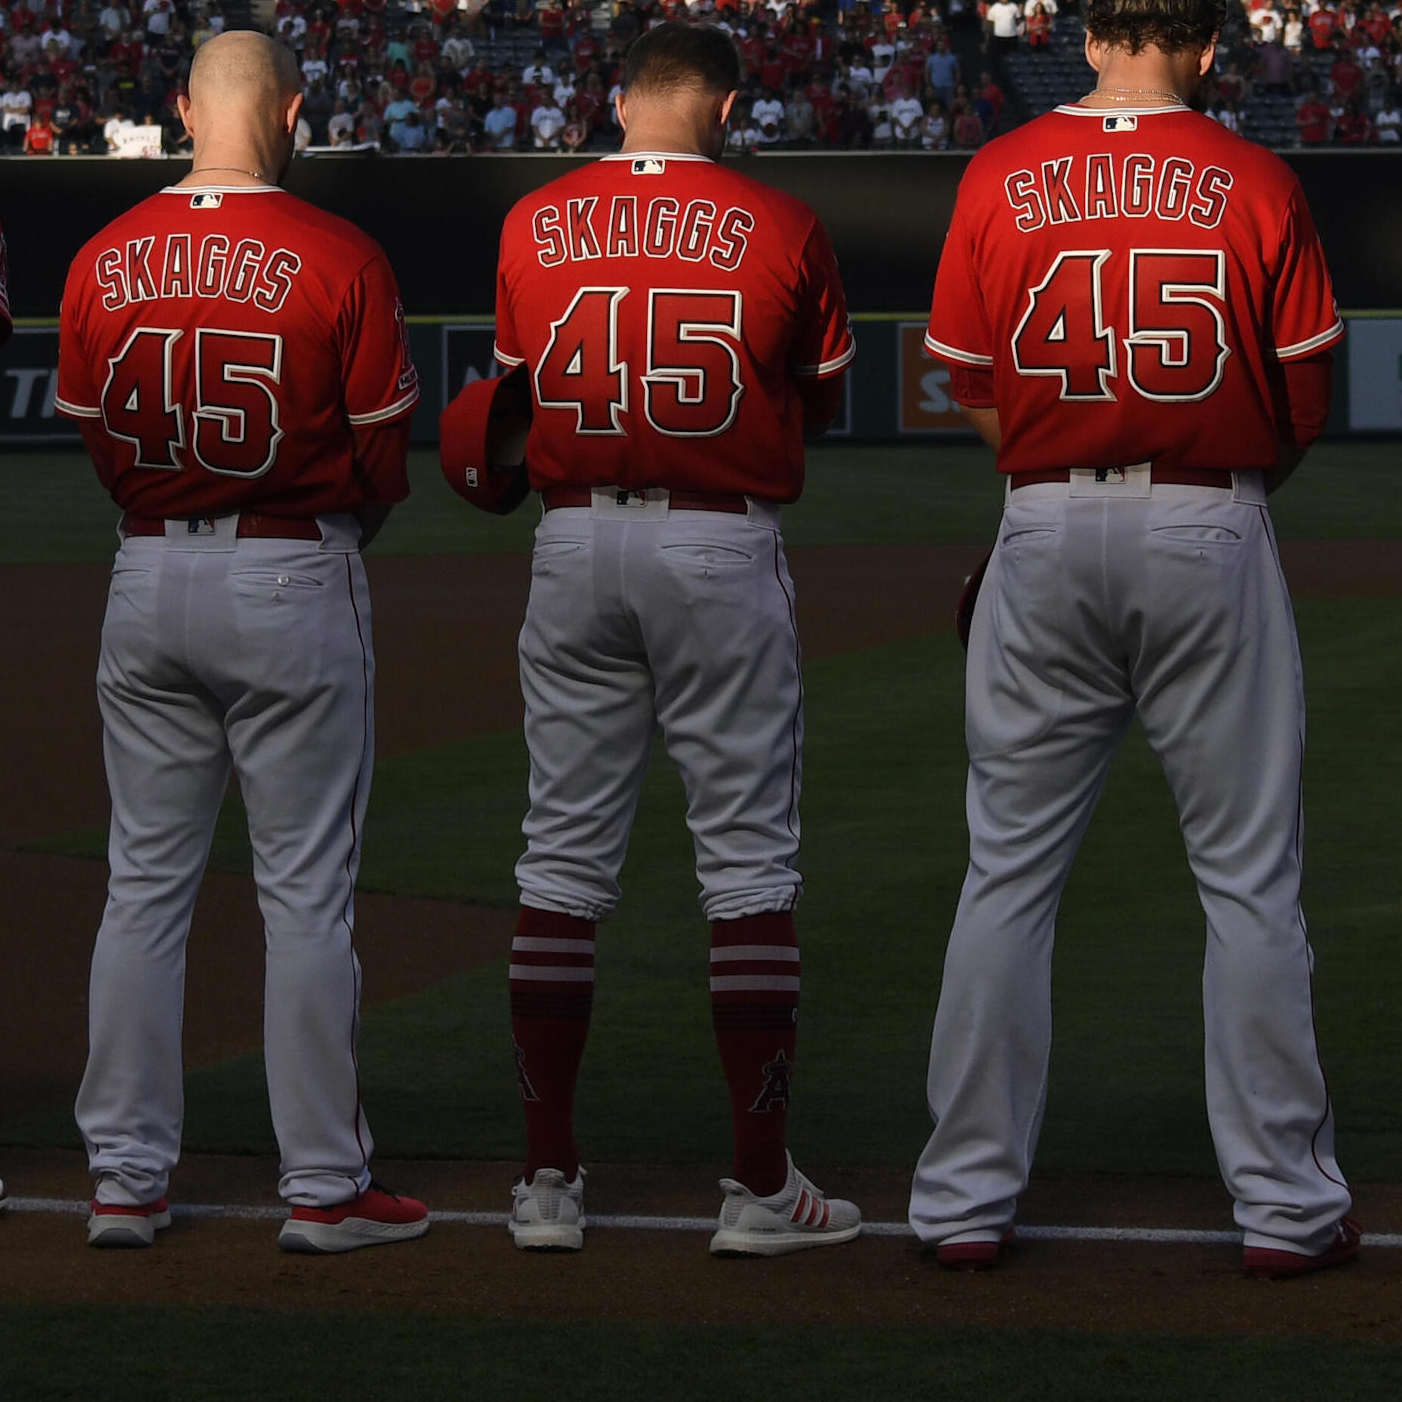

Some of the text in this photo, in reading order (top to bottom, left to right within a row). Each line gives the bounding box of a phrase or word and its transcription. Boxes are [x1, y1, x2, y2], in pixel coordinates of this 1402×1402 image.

[532, 196, 755, 271] SKAGGS
[1003, 153, 1235, 232] SKAGGS
[96, 233, 302, 313] SKAGGS
[1011, 248, 1232, 403] 45
[100, 326, 284, 478] 45
[533, 286, 744, 438] 45
